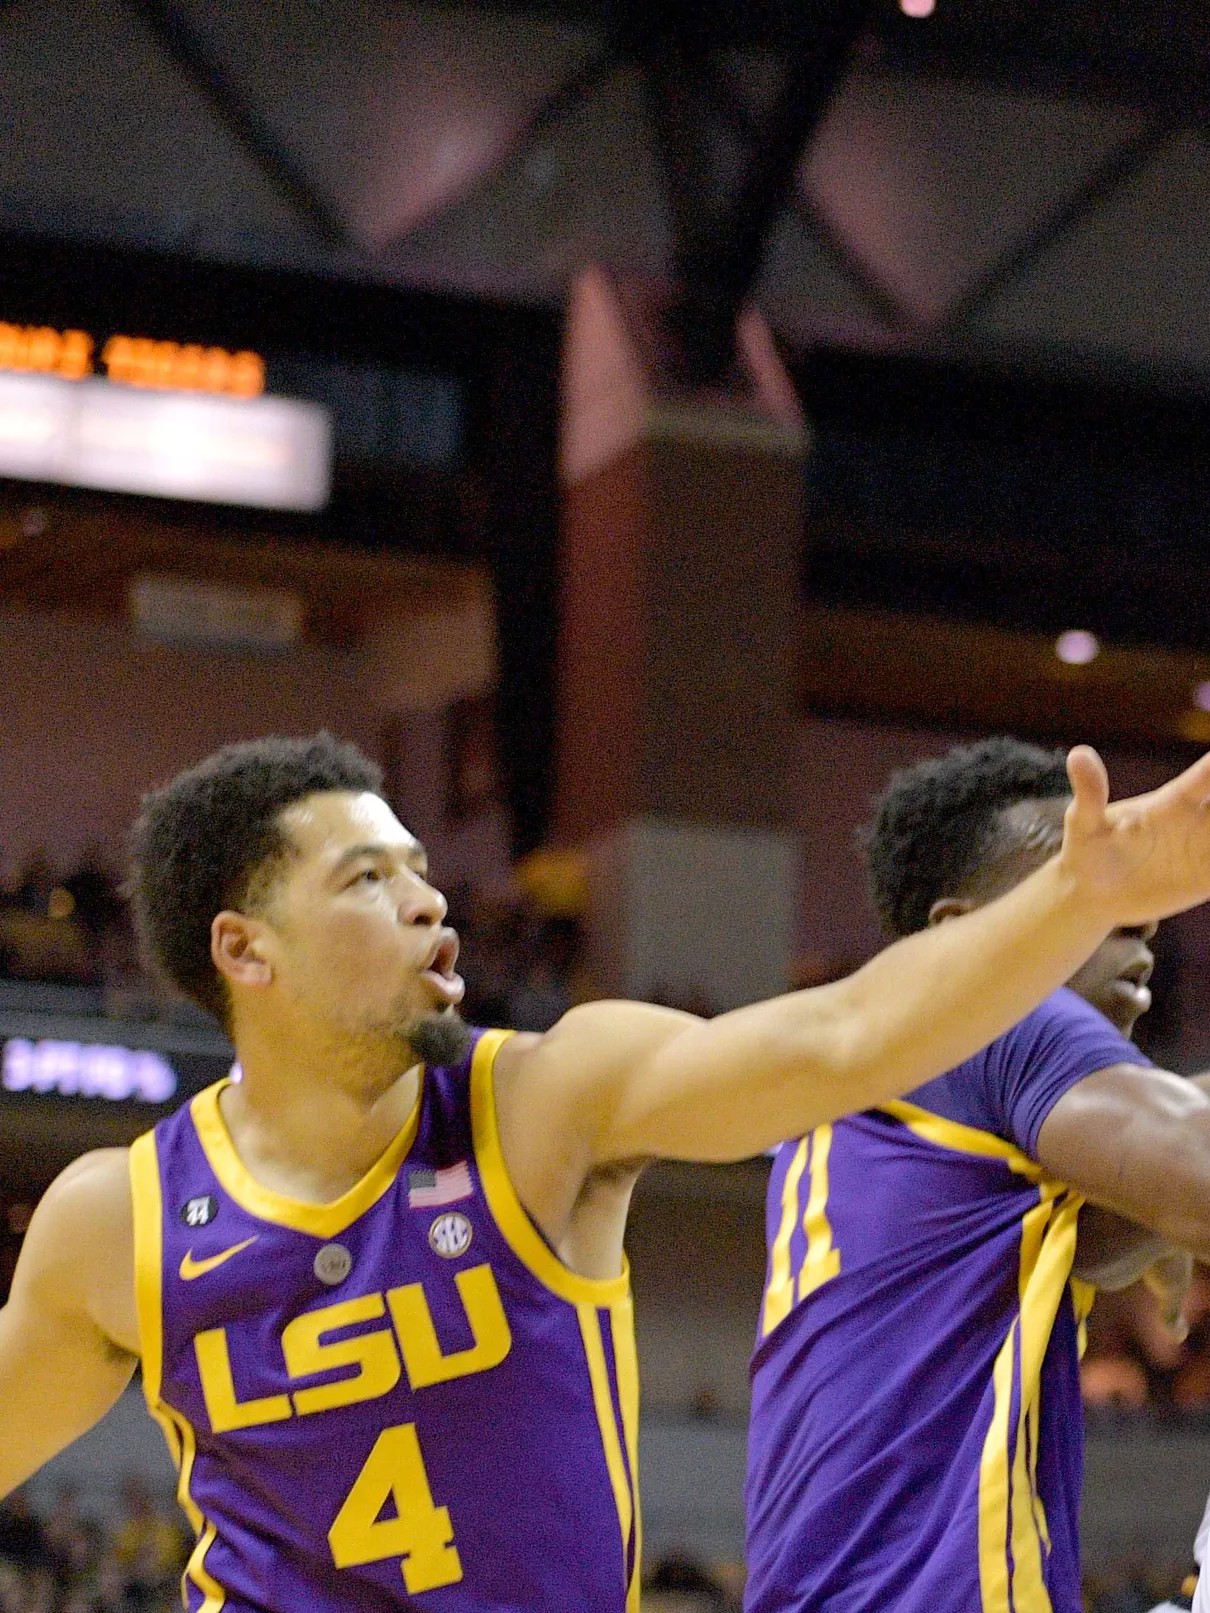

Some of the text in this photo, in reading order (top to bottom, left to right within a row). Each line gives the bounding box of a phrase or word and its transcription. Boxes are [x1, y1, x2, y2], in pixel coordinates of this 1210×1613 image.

[762, 1122, 842, 1337] 11
[194, 1262, 512, 1434] LSU
[327, 1421, 463, 1595] 4
